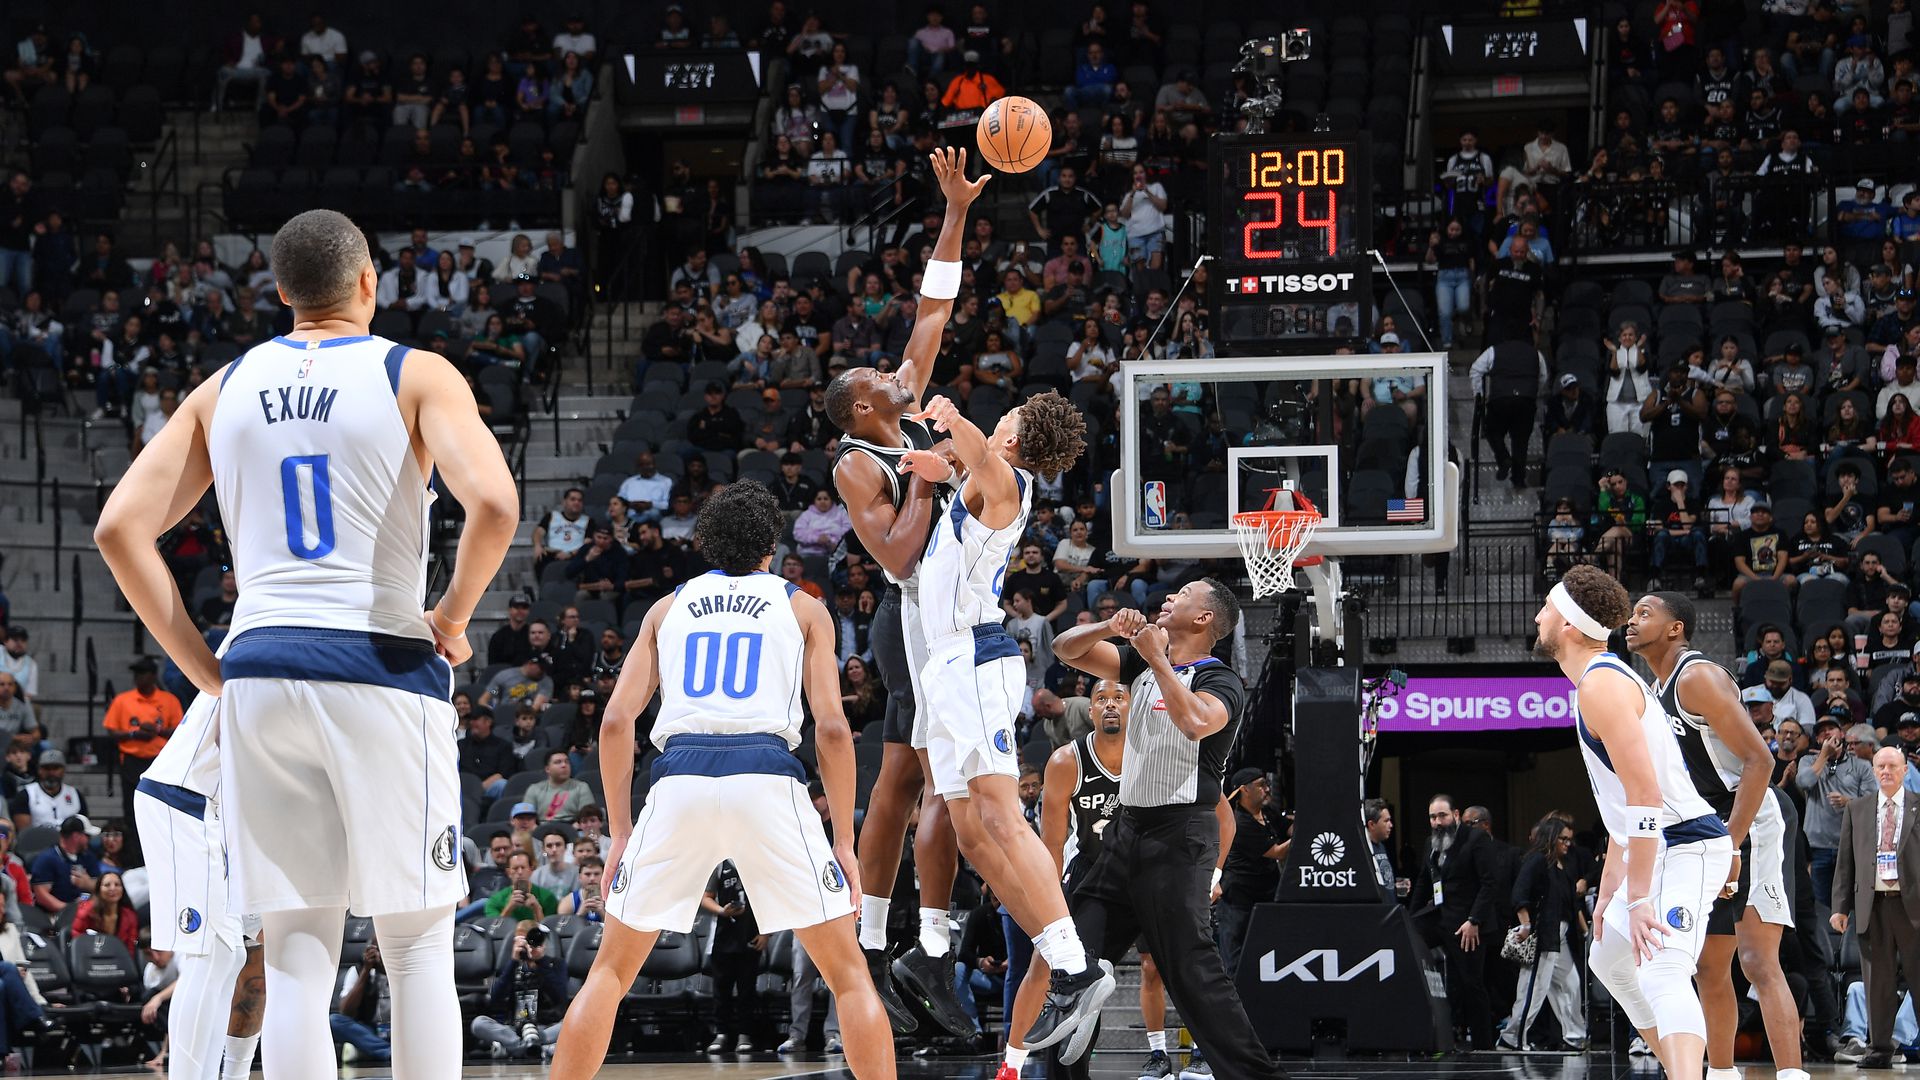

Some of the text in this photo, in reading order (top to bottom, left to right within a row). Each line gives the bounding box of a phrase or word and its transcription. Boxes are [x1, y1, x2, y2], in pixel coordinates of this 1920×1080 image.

[1250, 149, 1344, 187] 12:00
[1244, 190, 1337, 259] 24
[1260, 272, 1354, 293] TISSOT
[259, 386, 338, 425] EXUM
[281, 454, 336, 560] 0
[687, 594, 772, 620] CHRISTIE
[683, 631, 763, 699] 00
[1405, 692, 1512, 726] Spurs
[1517, 691, 1575, 719] Go!
[1639, 821, 1657, 831] 31
[1299, 865, 1357, 888] Frost
[1259, 948, 1395, 982] KIA
